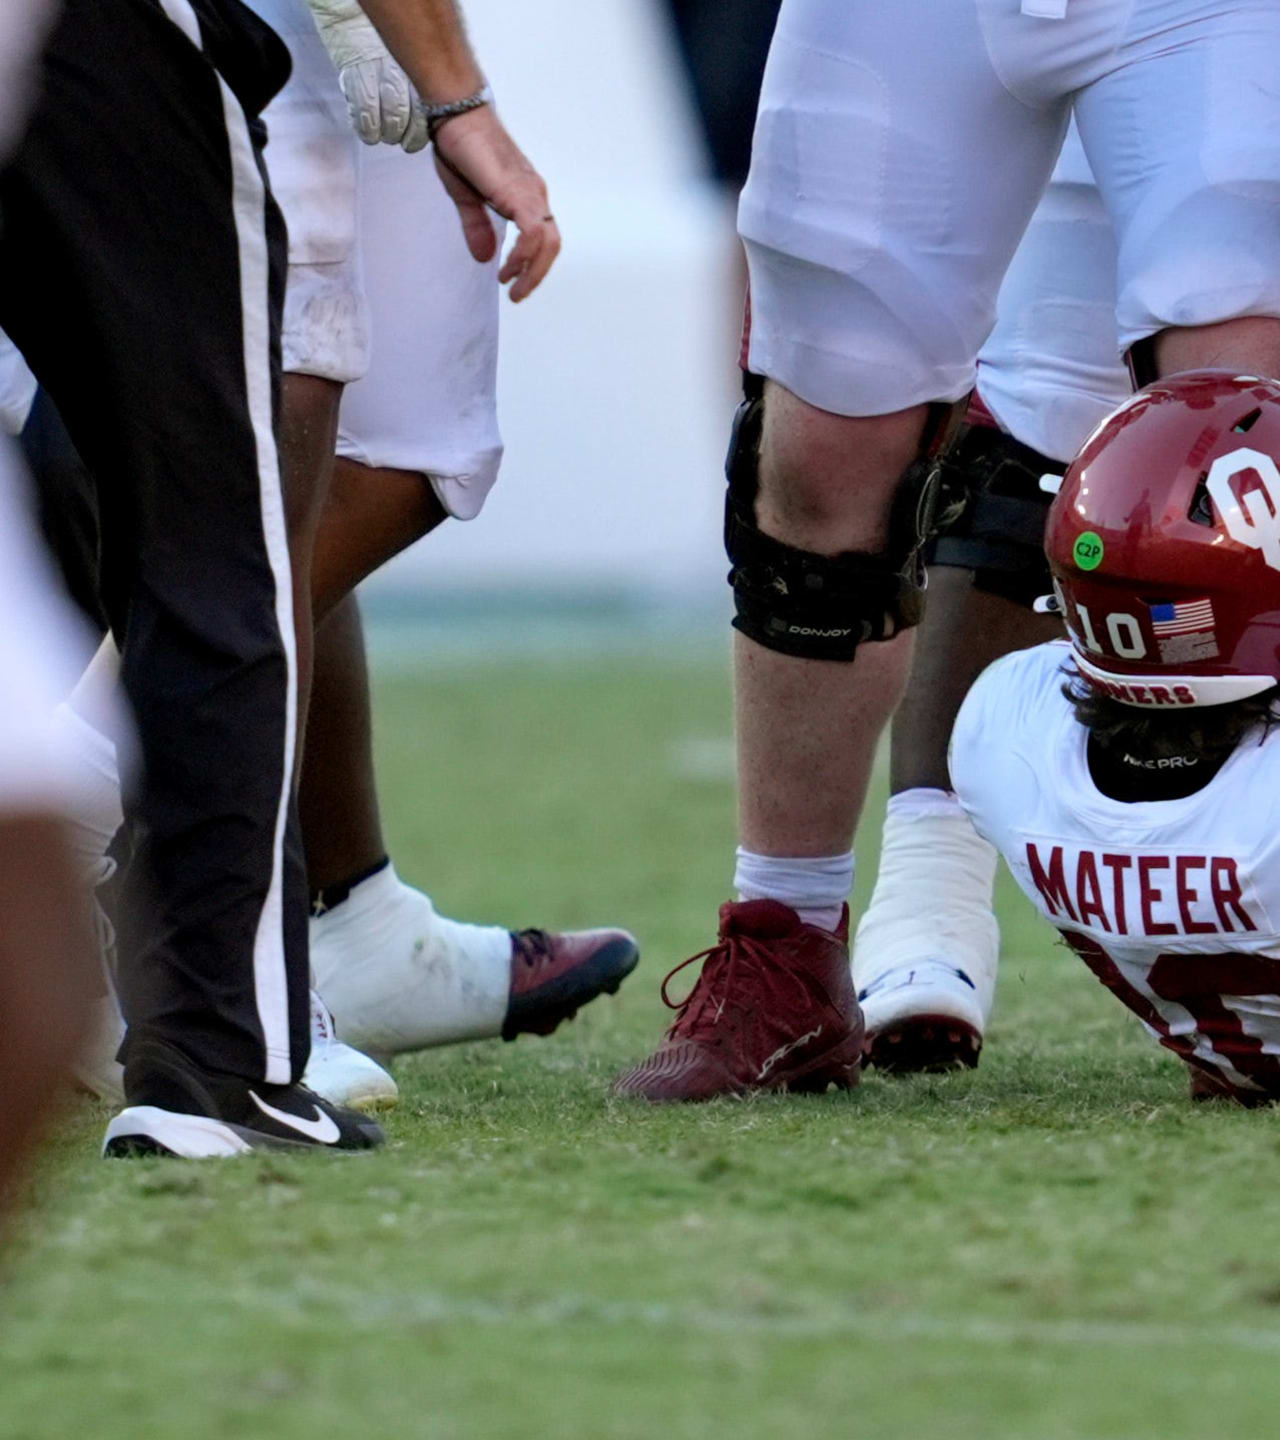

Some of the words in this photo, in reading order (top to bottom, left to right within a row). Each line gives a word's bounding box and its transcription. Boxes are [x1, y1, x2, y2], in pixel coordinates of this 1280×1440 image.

[1076, 542, 1100, 558] C2P
[788, 625, 852, 637] DONJOY
[1076, 603, 1148, 660] 10
[1026, 842, 1258, 937] MATEER
